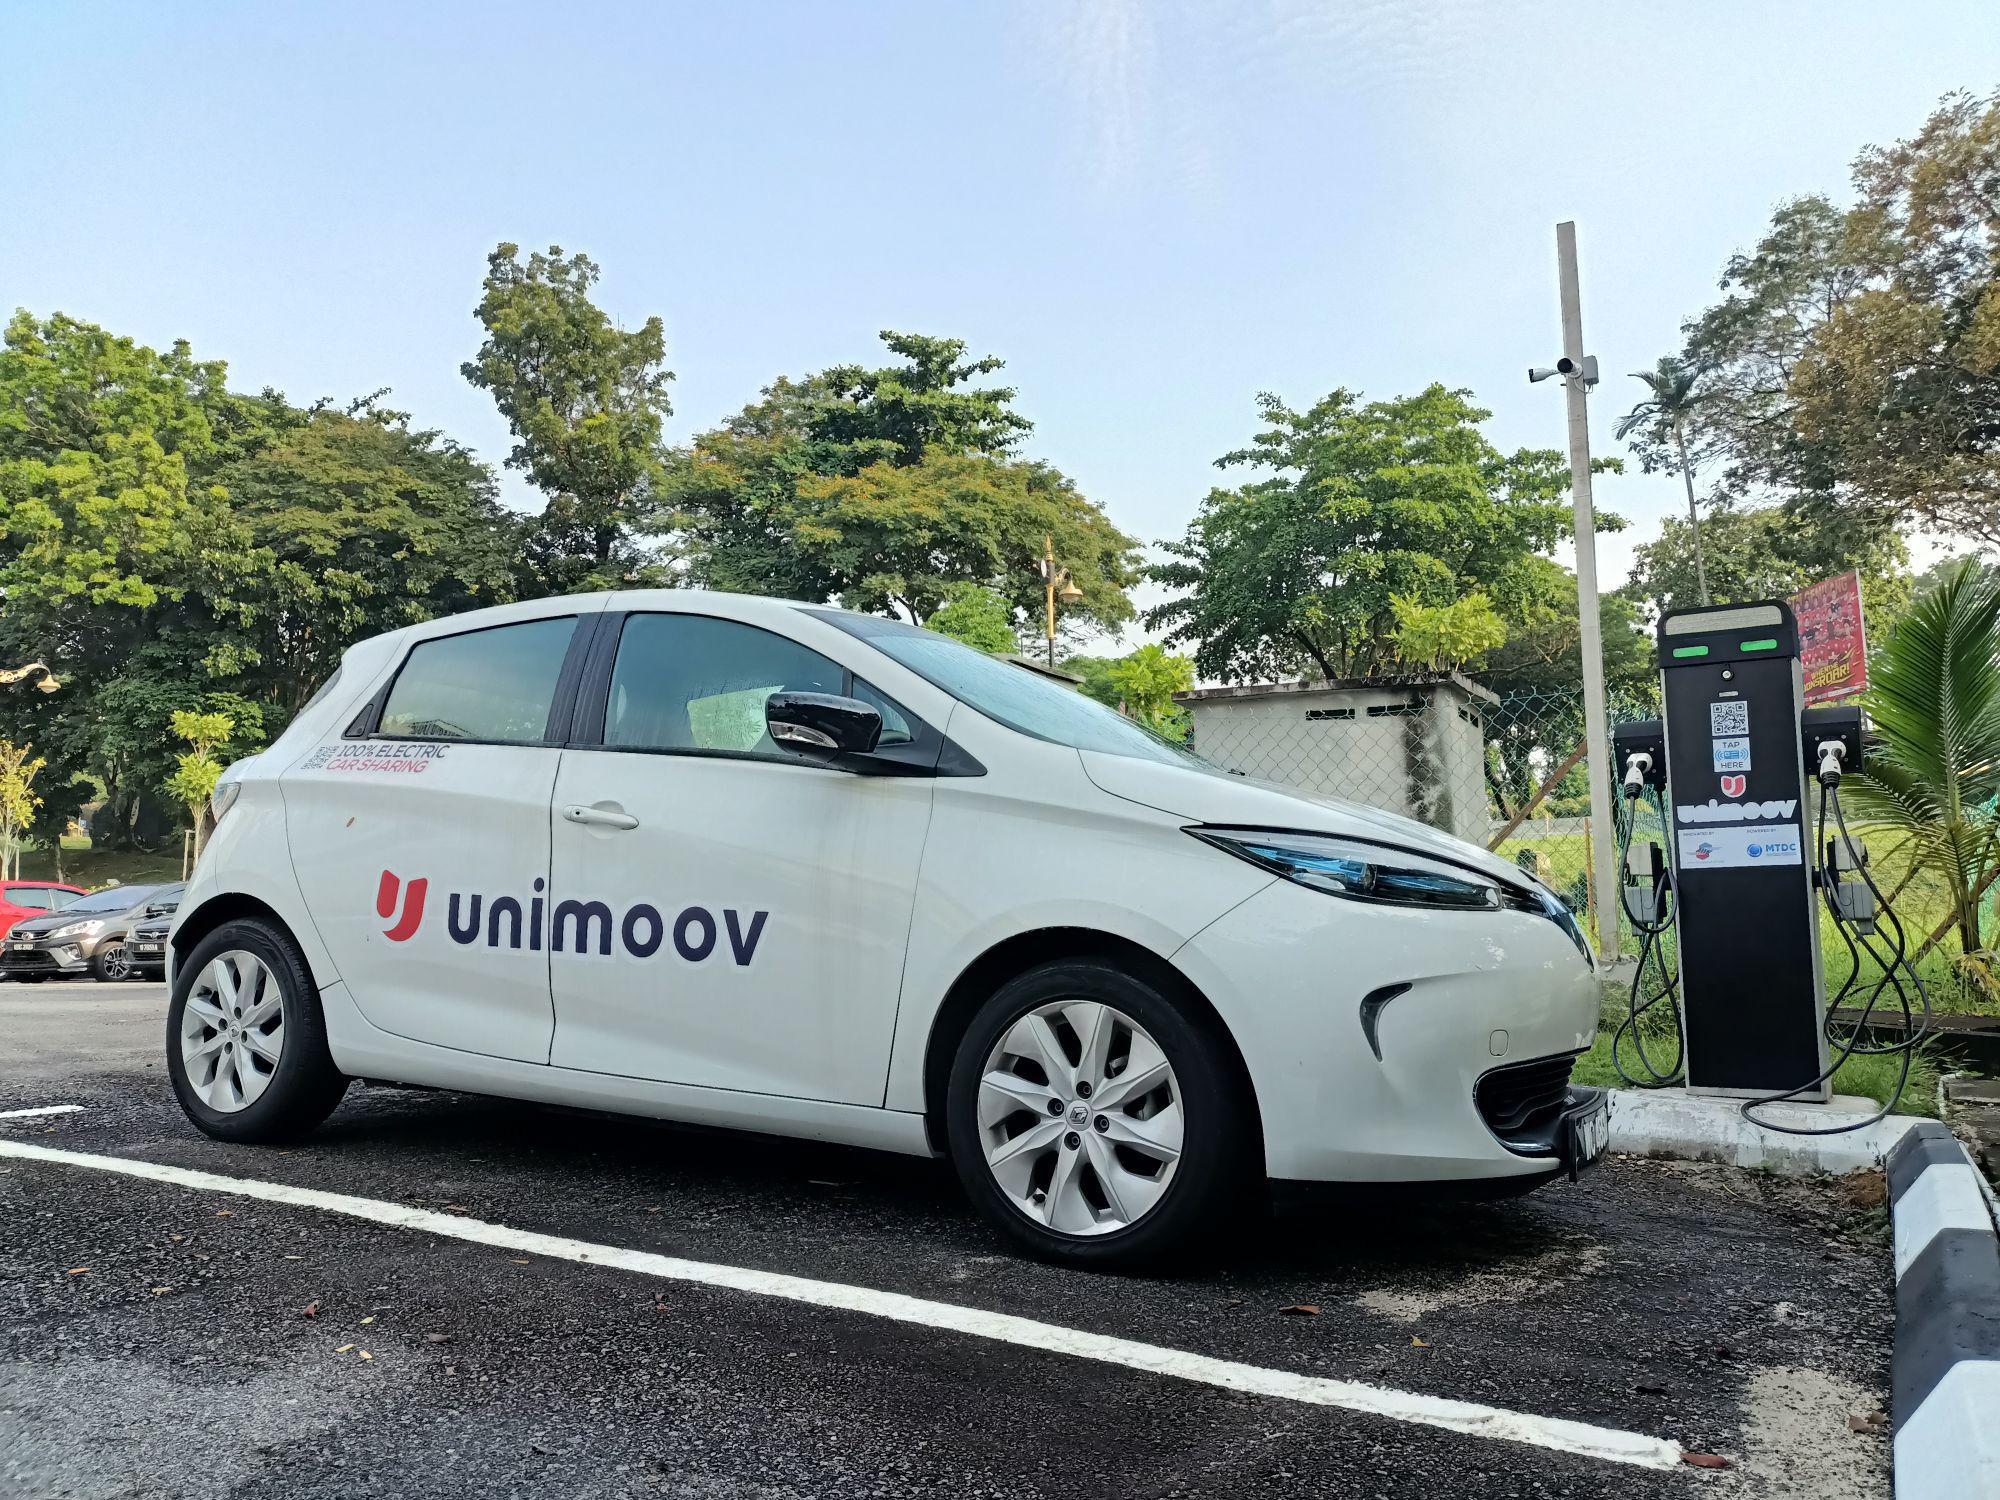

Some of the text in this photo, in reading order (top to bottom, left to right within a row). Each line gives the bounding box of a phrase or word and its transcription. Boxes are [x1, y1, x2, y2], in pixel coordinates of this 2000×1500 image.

[1819, 662, 1850, 688] ROAR!
[337, 744, 451, 759] 100% ELECTRIC
[326, 758, 429, 773] CAR SHARING
[1720, 761, 1744, 769] HERE
[1765, 843, 1796, 852] MTDC
[447, 876, 770, 967] unimoov
